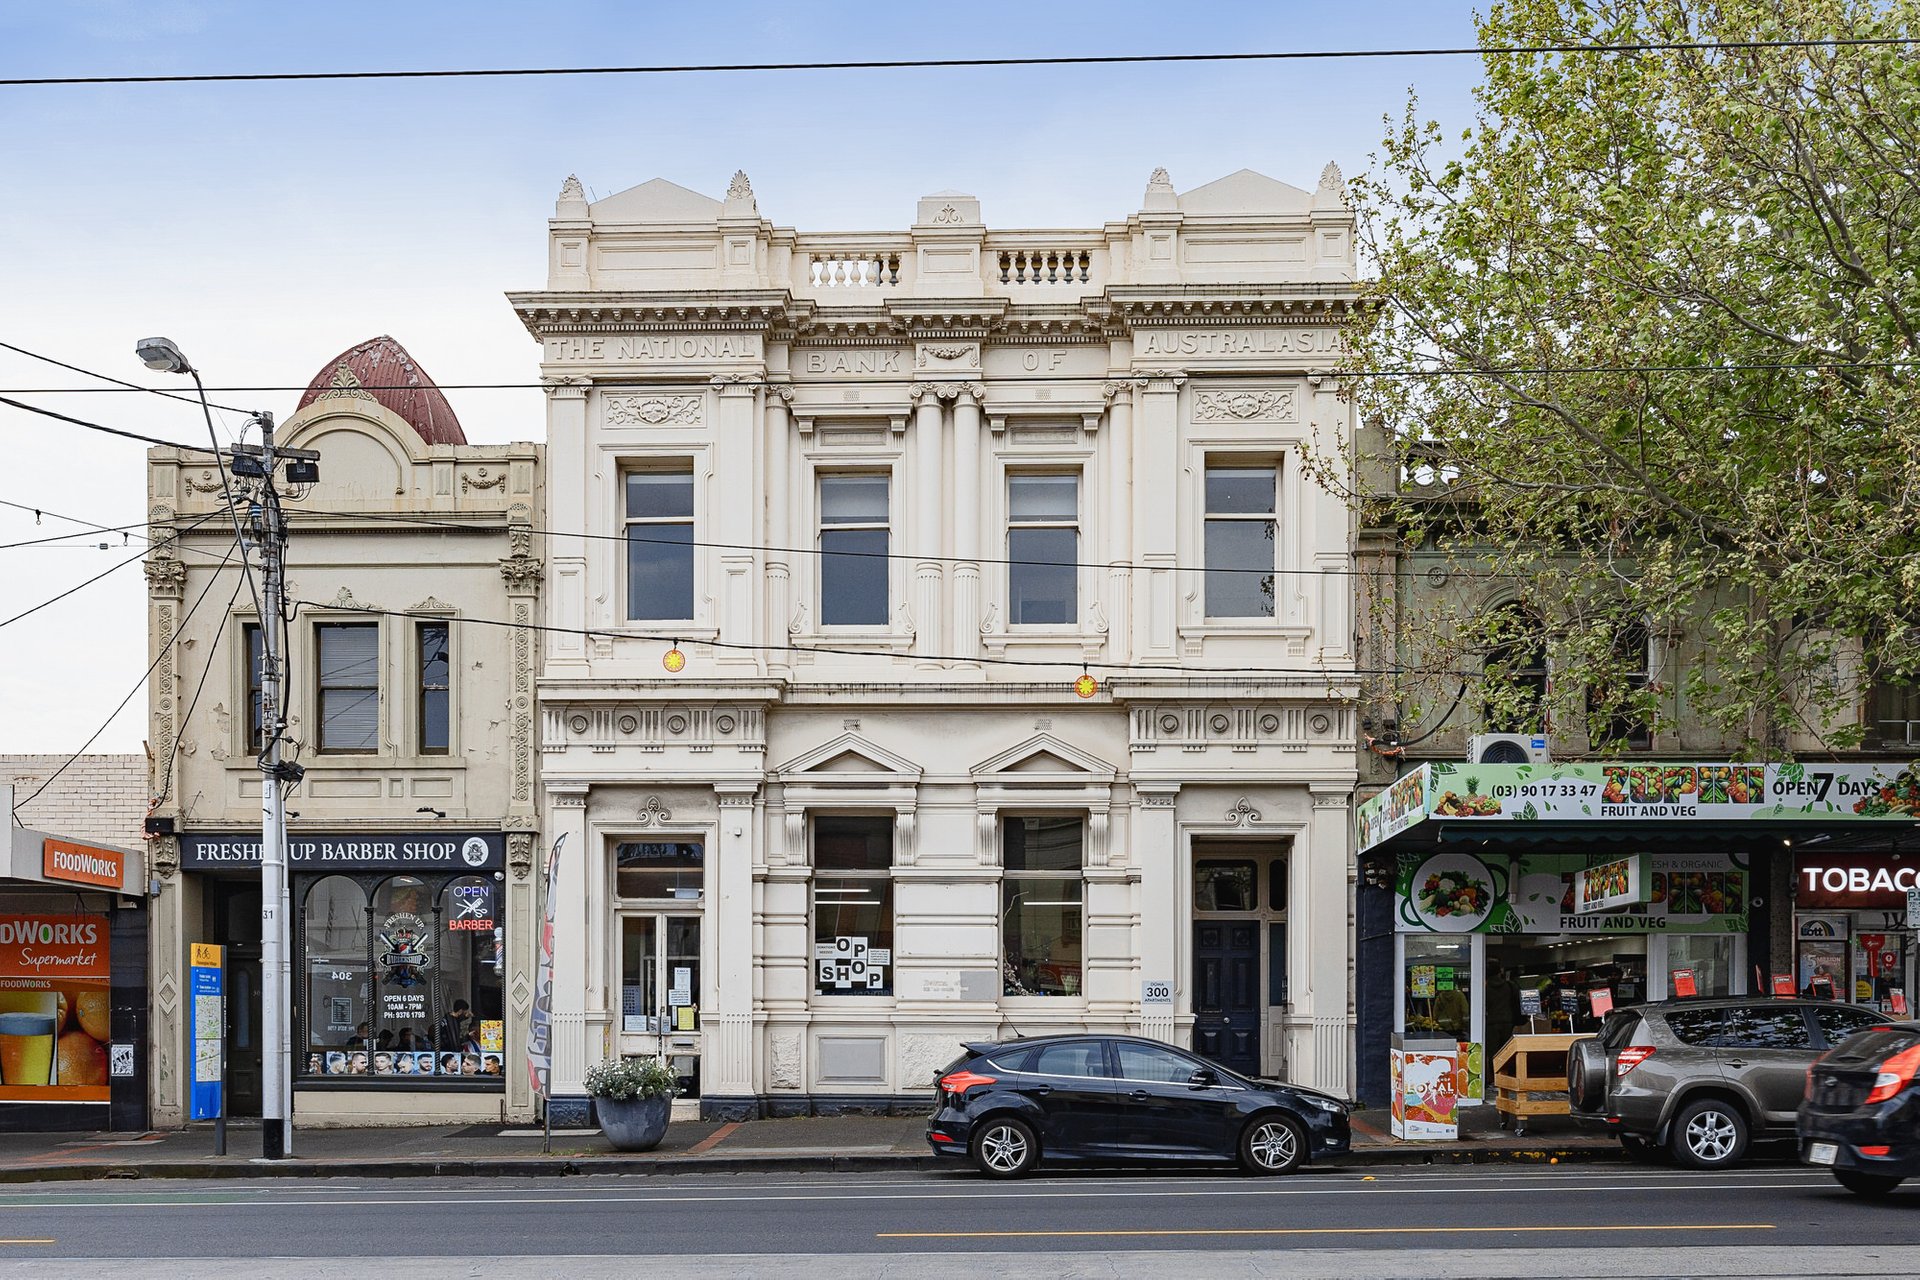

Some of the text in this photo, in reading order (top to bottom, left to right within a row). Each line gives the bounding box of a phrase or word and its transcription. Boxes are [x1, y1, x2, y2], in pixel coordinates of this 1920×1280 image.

[551, 335, 757, 360] THE NATIONAL
[1143, 330, 1343, 353] AUSTRALASIA
[806, 351, 901, 373] BANK
[1022, 350, 1067, 371] OF
[1491, 784, 1597, 798] (03) 90 17 33 47
[1772, 773, 1881, 802] OPEN 7 DAYS
[1601, 806, 1697, 817] FRUIT AND VEG
[289, 843, 316, 860] UP
[321, 843, 398, 860] BARBER
[403, 842, 456, 861] SHOP
[53, 850, 117, 878] FOODWORKS
[1651, 860, 1669, 869] ESH
[1681, 860, 1723, 869] ORGANIC
[1802, 867, 1920, 892] TOBAC
[453, 886, 489, 897] OPEN
[1908, 891, 1916, 901] P
[263, 909, 273, 919] 31
[384, 912, 425, 929] FRESHEN UP
[1560, 916, 1666, 929] FRUIT AND VEG
[449, 919, 494, 931] BARBER
[836, 938, 866, 958] OP
[19, 947, 97, 973] Supermarket
[821, 960, 881, 987] SHOP
[0, 979, 52, 988] FOODWORKS
[1146, 987, 1169, 998] 300
